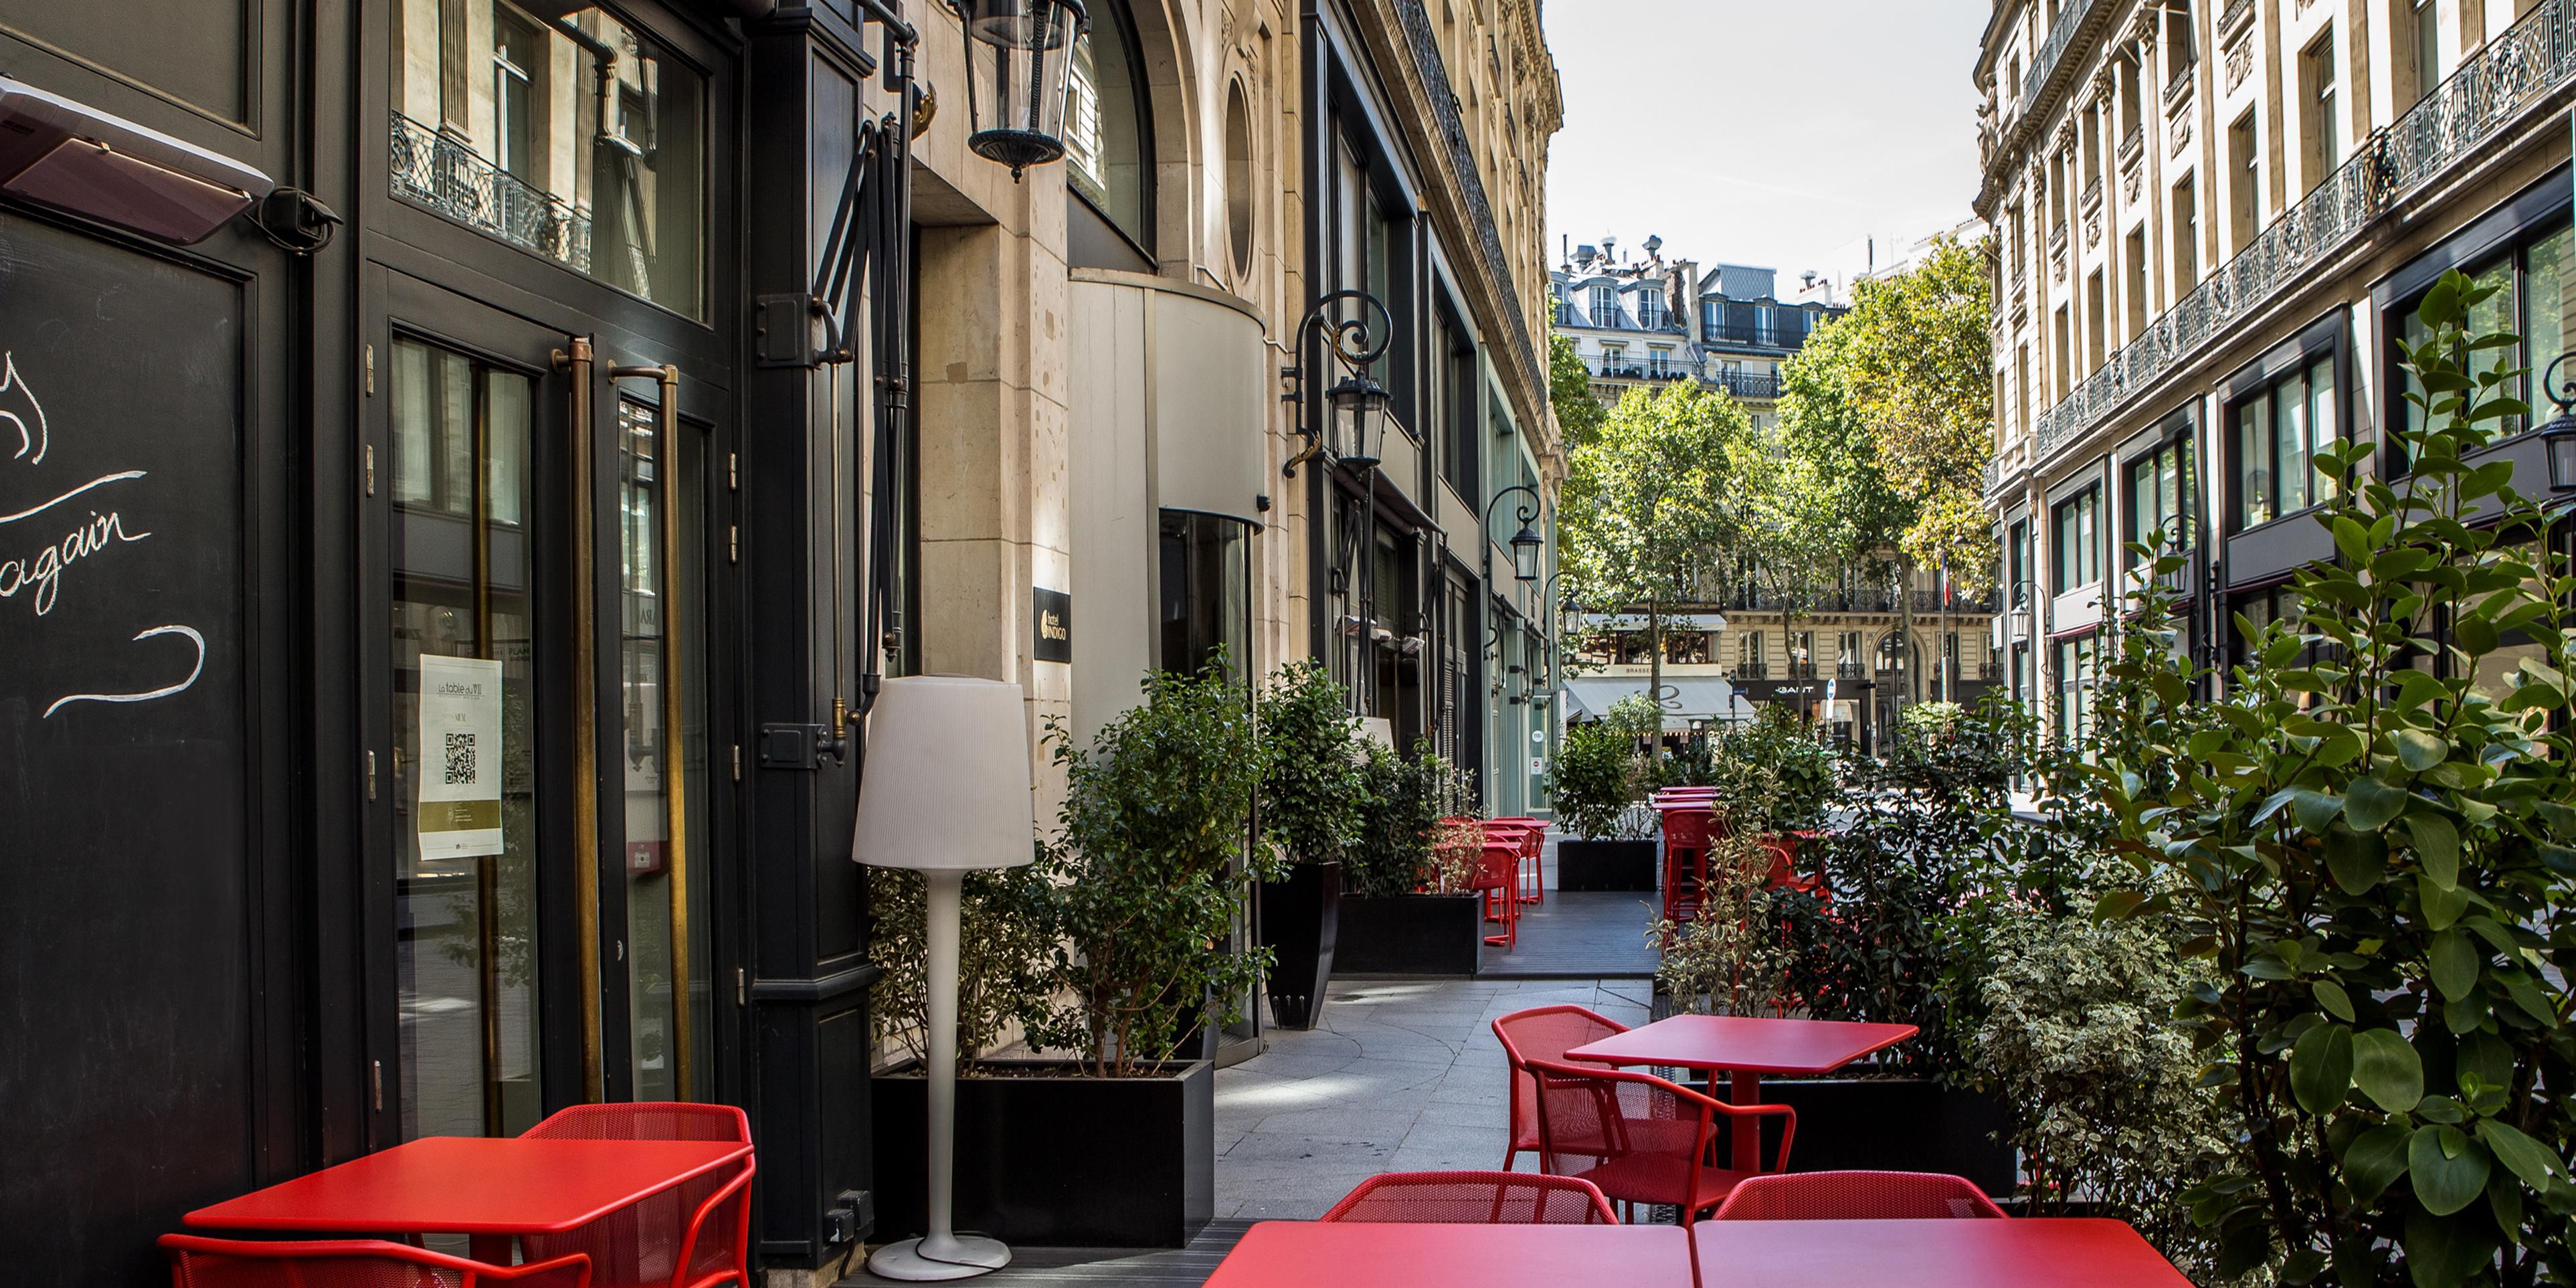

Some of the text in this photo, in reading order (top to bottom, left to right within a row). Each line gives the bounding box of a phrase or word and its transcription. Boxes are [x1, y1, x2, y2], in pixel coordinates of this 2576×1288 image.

[0, 511, 151, 616] again
[1048, 612, 1059, 626] hotel
[1048, 625, 1066, 640] INDIGO
[438, 684, 445, 693] La
[446, 682, 464, 693] table
